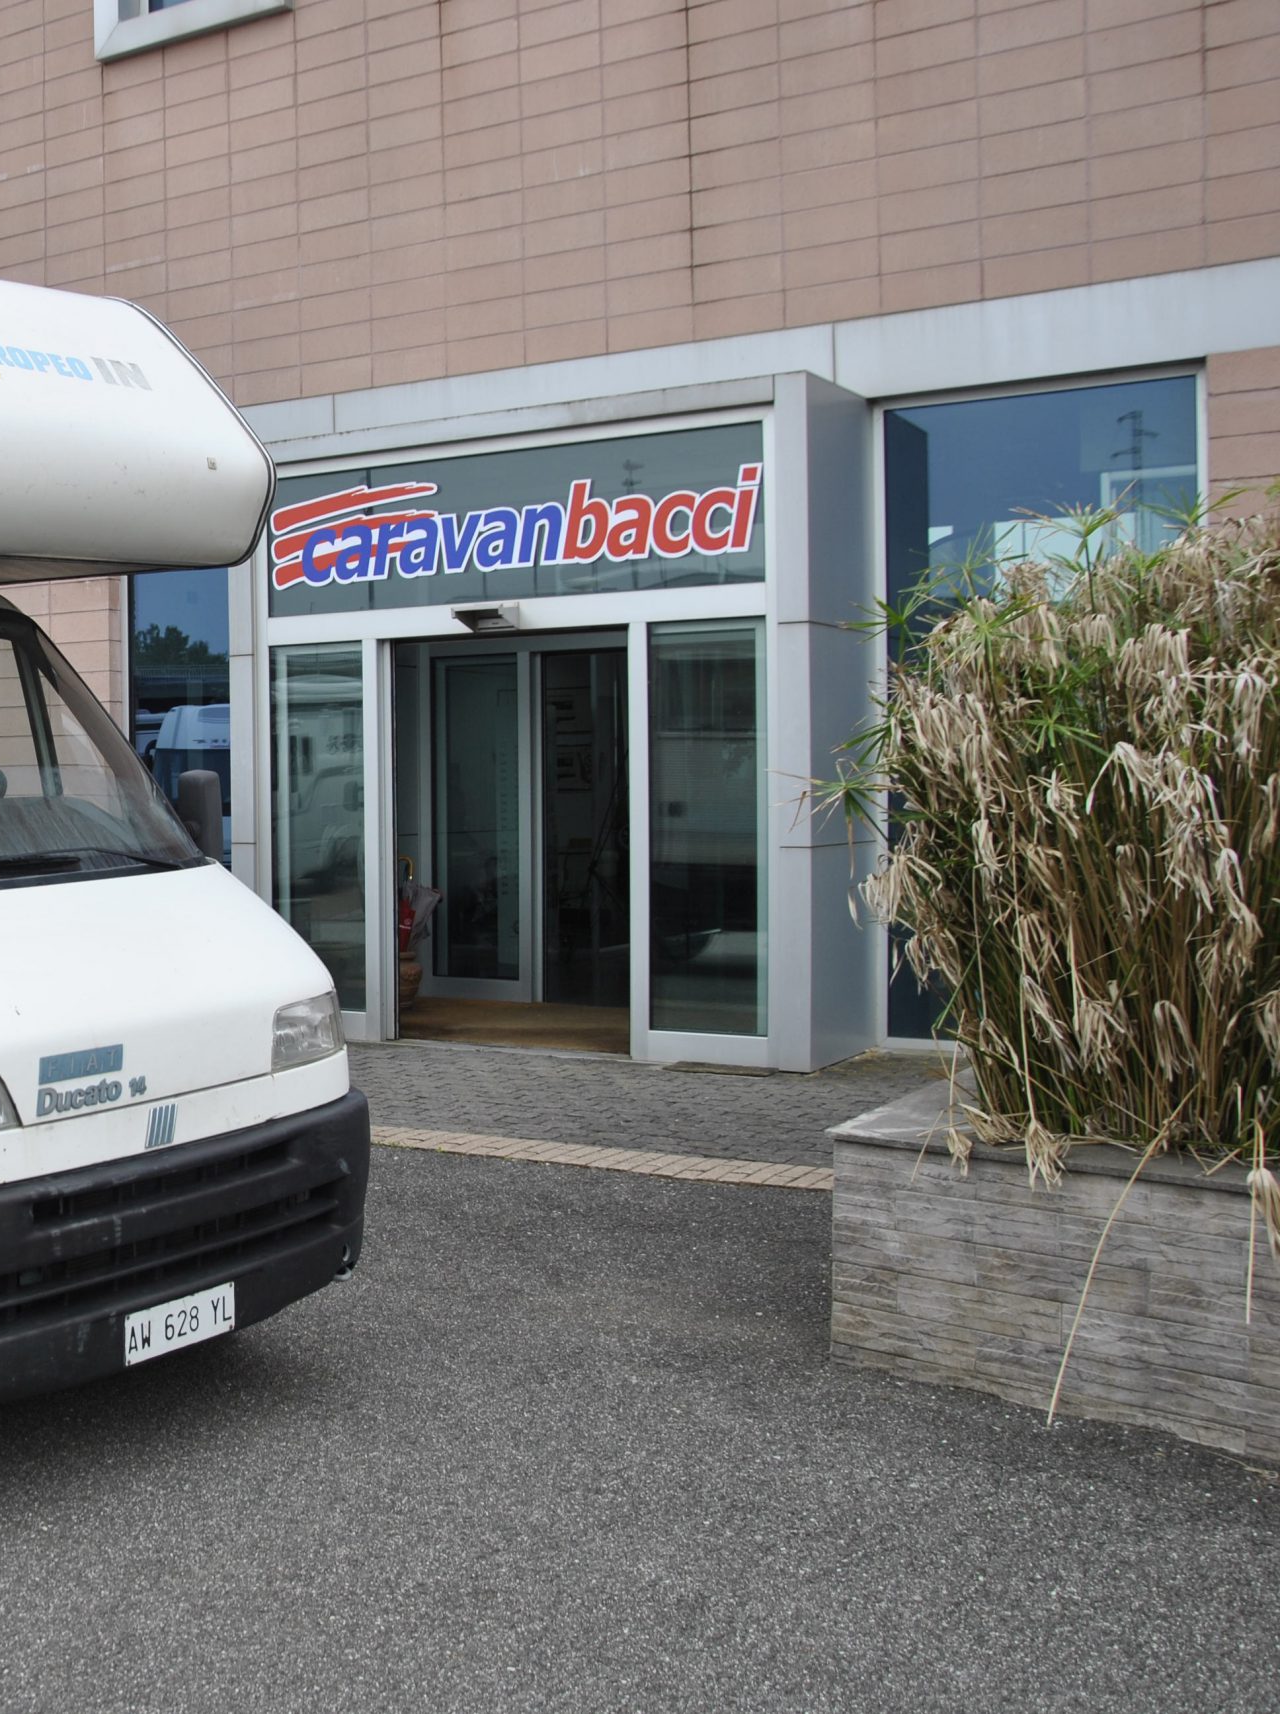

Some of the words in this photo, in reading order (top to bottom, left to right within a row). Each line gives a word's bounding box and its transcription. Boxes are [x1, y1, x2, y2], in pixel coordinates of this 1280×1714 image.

[90, 356, 153, 391] IN
[299, 463, 761, 586] caravanbacci
[46, 1049, 120, 1079] FIAT
[36, 1078, 122, 1117] Ducato
[129, 1075, 147, 1098] 14
[128, 1320, 151, 1354] AW
[164, 1305, 199, 1341] 628
[211, 1295, 232, 1325] YL
